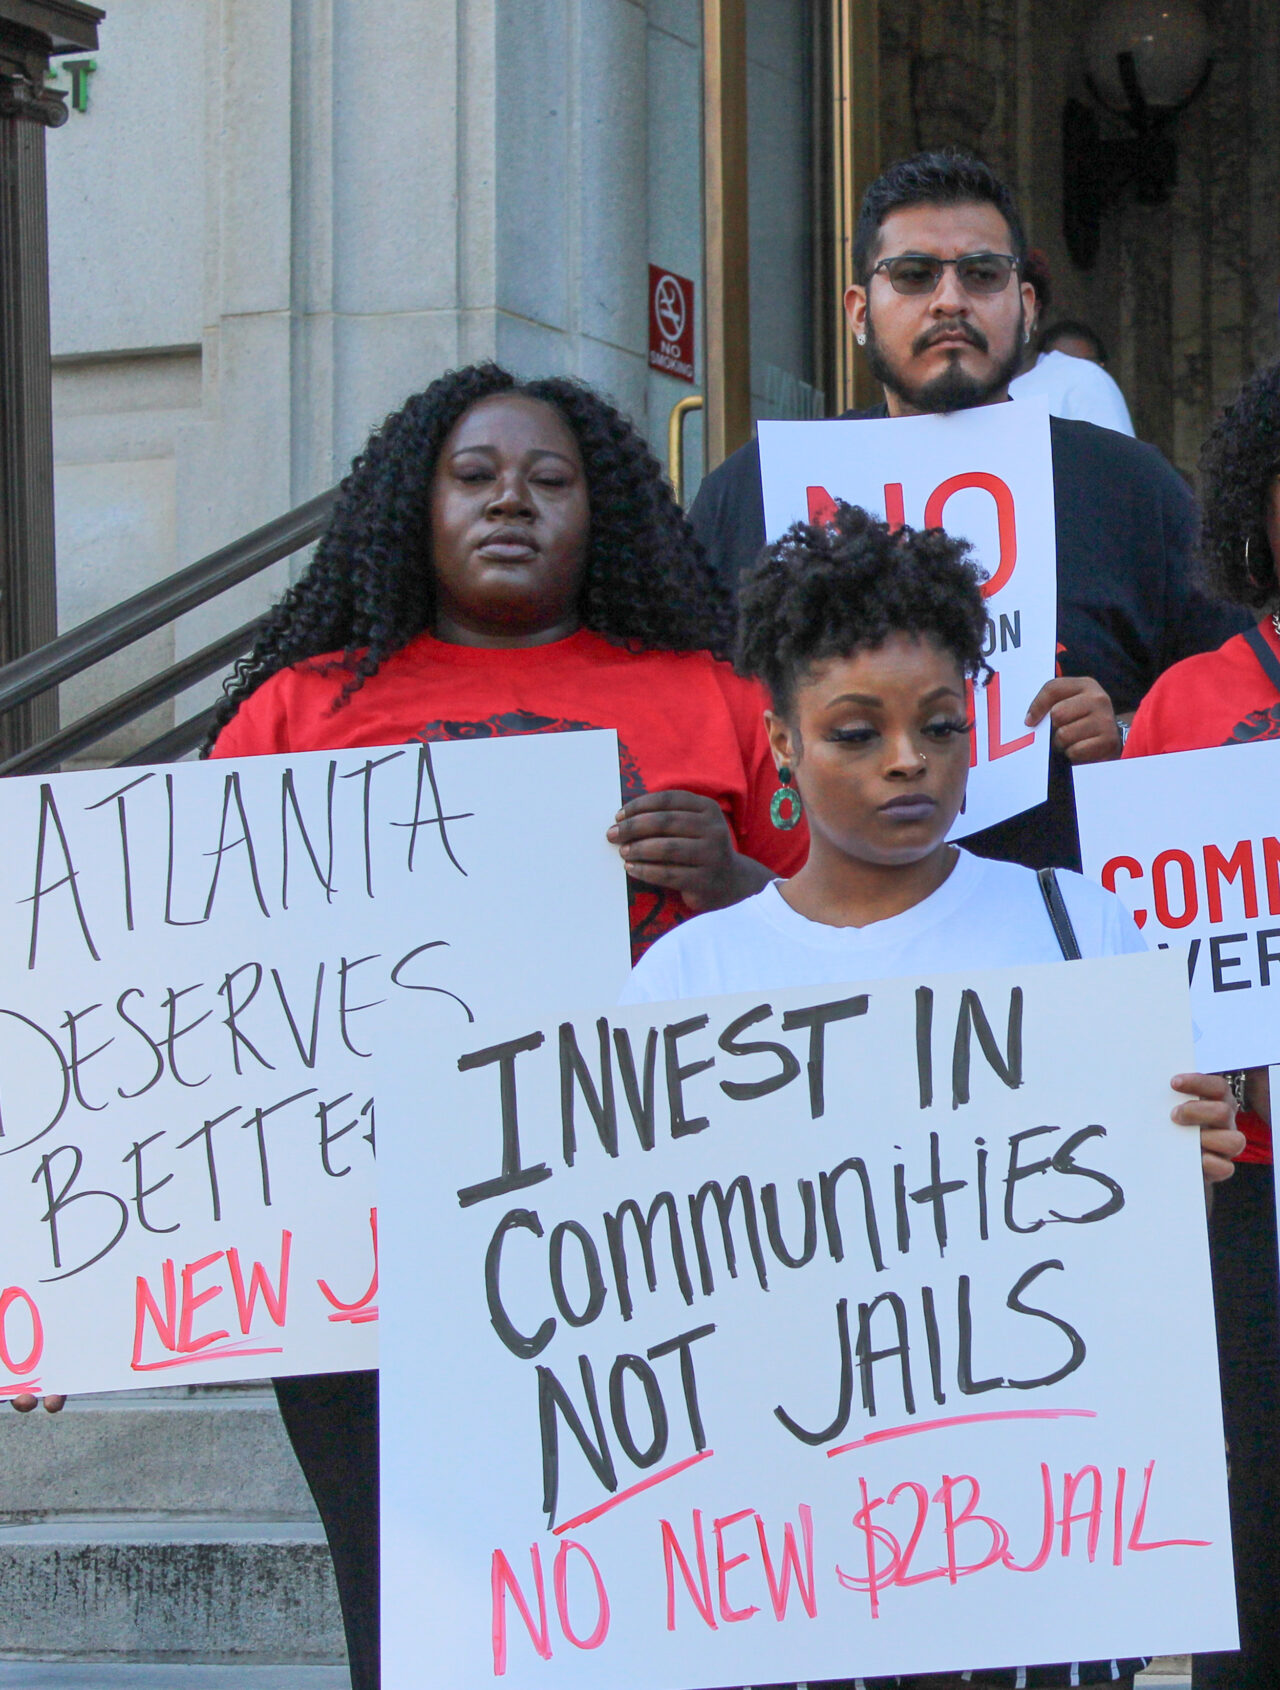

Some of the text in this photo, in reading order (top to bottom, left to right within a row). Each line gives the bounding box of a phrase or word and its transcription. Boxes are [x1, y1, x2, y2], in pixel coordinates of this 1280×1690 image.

[650, 350, 693, 378] SMOKING
[660, 341, 681, 358] NO
[17, 743, 474, 969] ATLANTA
[457, 986, 1024, 1208] INVEST IN
[131, 1229, 292, 1367] NEW
[537, 1260, 1087, 1530] NOT JAILS
[491, 1539, 610, 1676] NO
[660, 1504, 817, 1632] NEW
